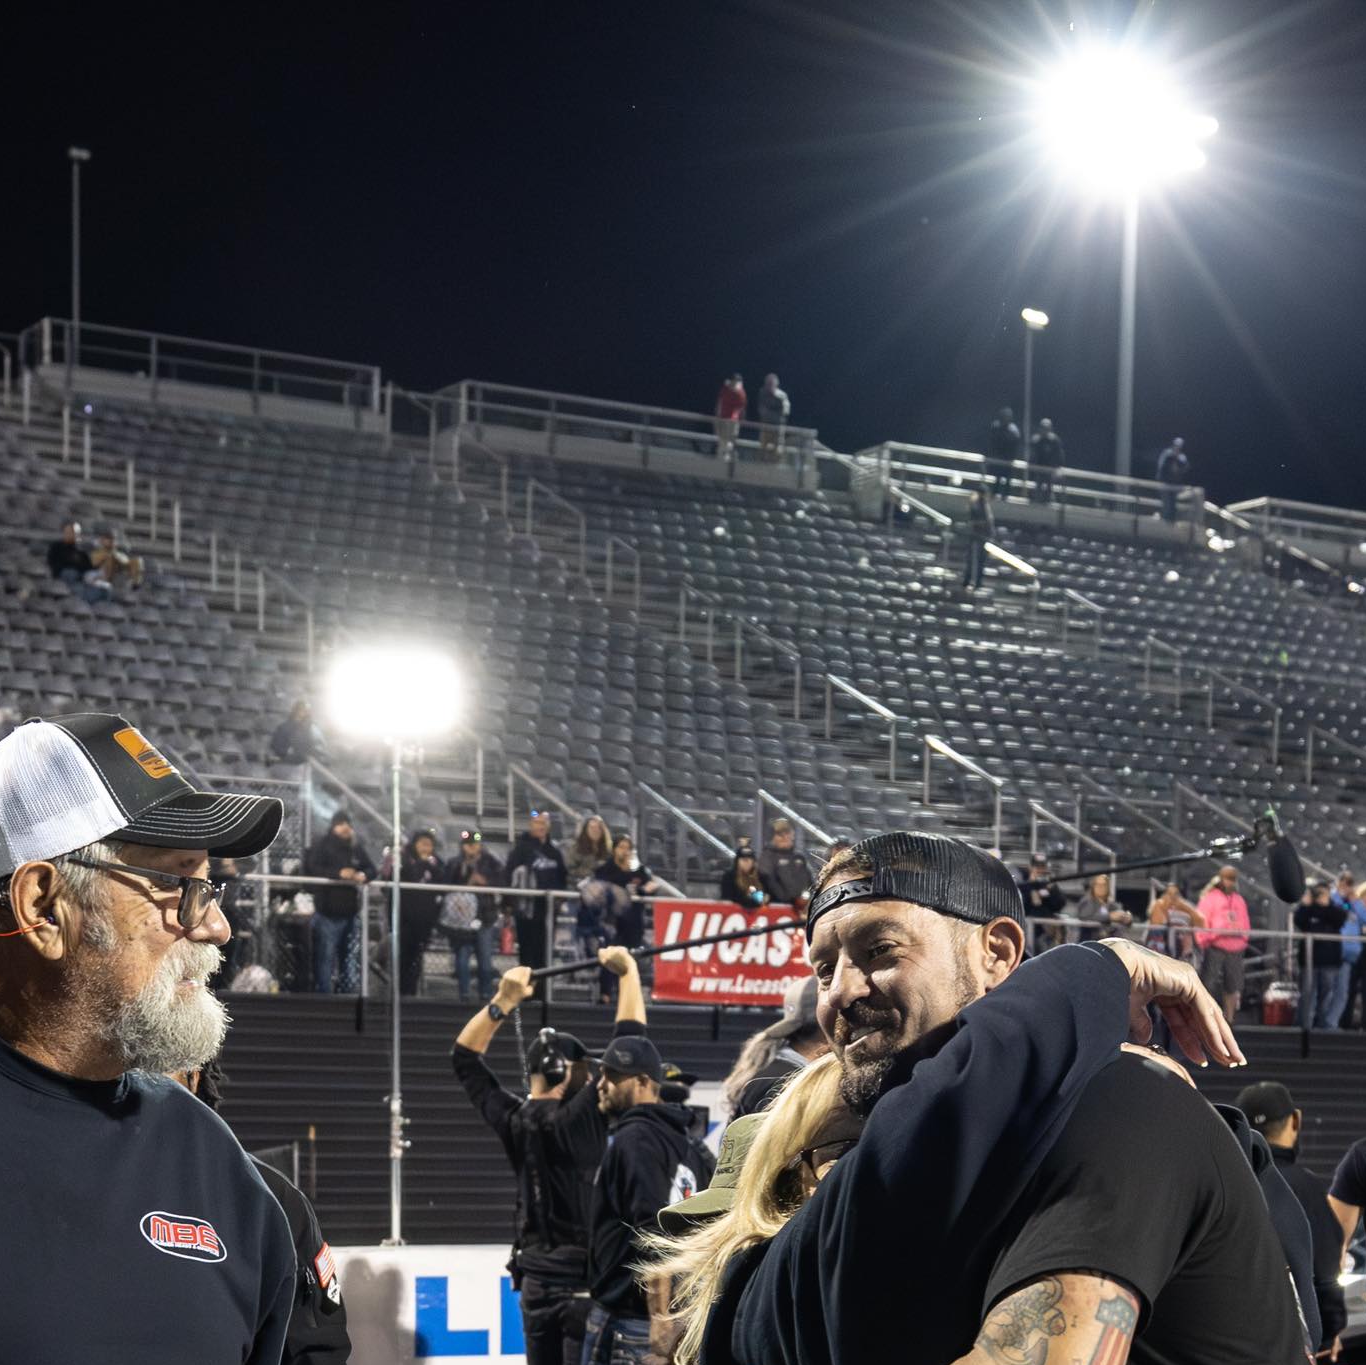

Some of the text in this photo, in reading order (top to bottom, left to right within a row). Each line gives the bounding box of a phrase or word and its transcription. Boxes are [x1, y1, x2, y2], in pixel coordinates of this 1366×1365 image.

[660, 911, 795, 967] LUCAS
[689, 974, 802, 995] www.LucasO
[150, 1216, 219, 1253] MBE
